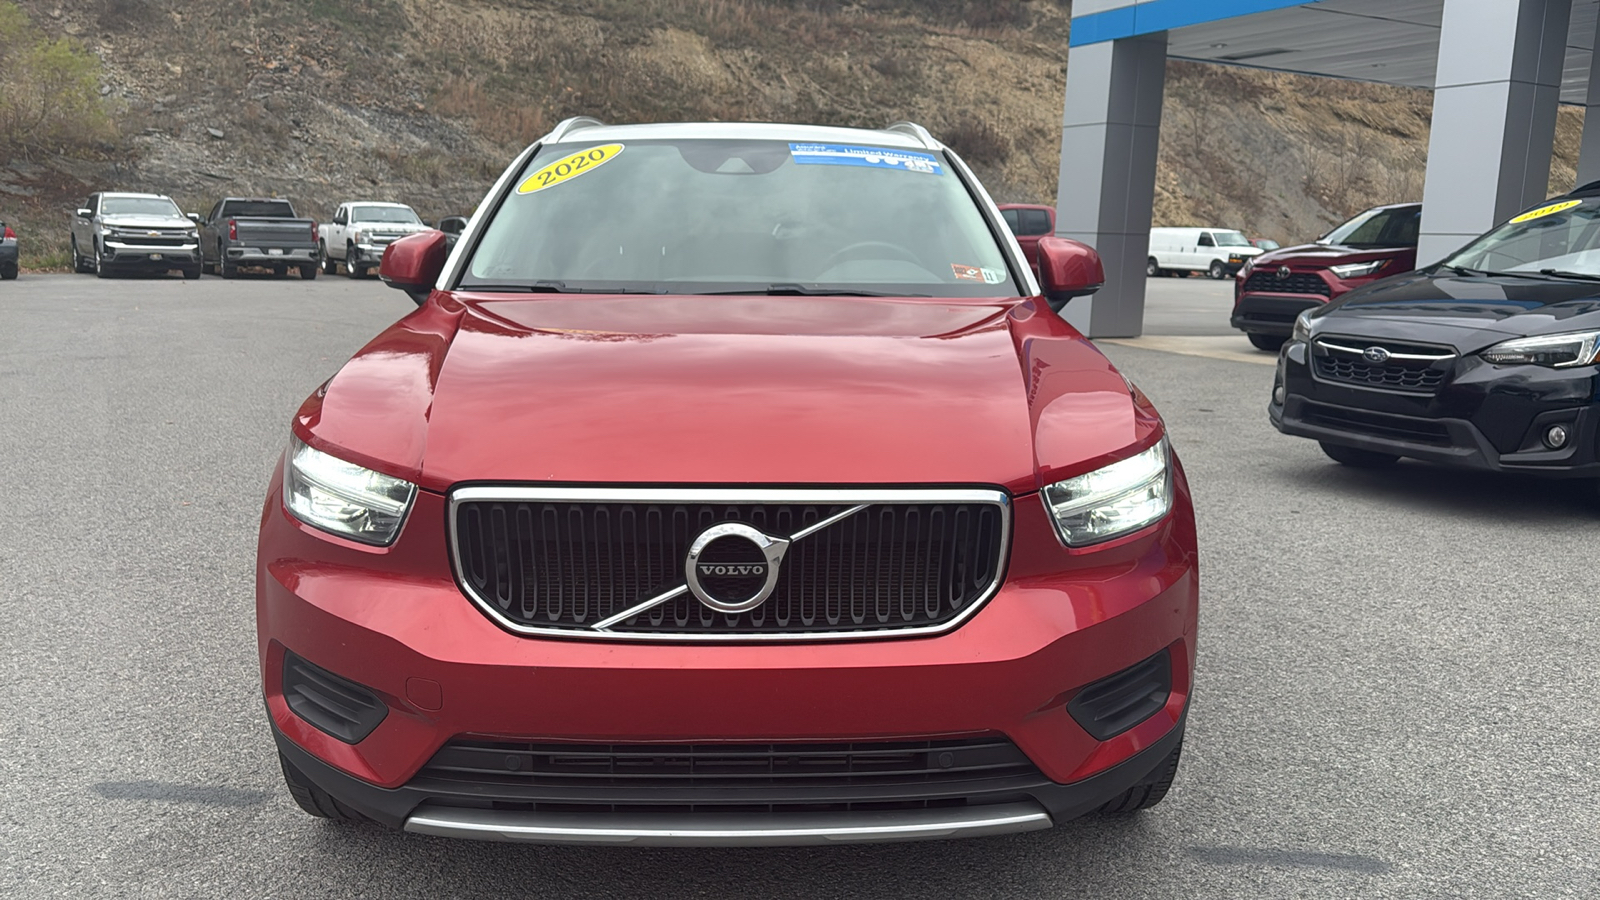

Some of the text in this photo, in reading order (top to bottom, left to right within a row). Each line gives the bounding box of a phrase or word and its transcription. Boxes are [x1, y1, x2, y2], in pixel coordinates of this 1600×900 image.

[844, 148, 881, 156] Limited
[883, 152, 930, 162] Warranty
[538, 149, 605, 186] 2020
[700, 566, 764, 575] VOLVO
